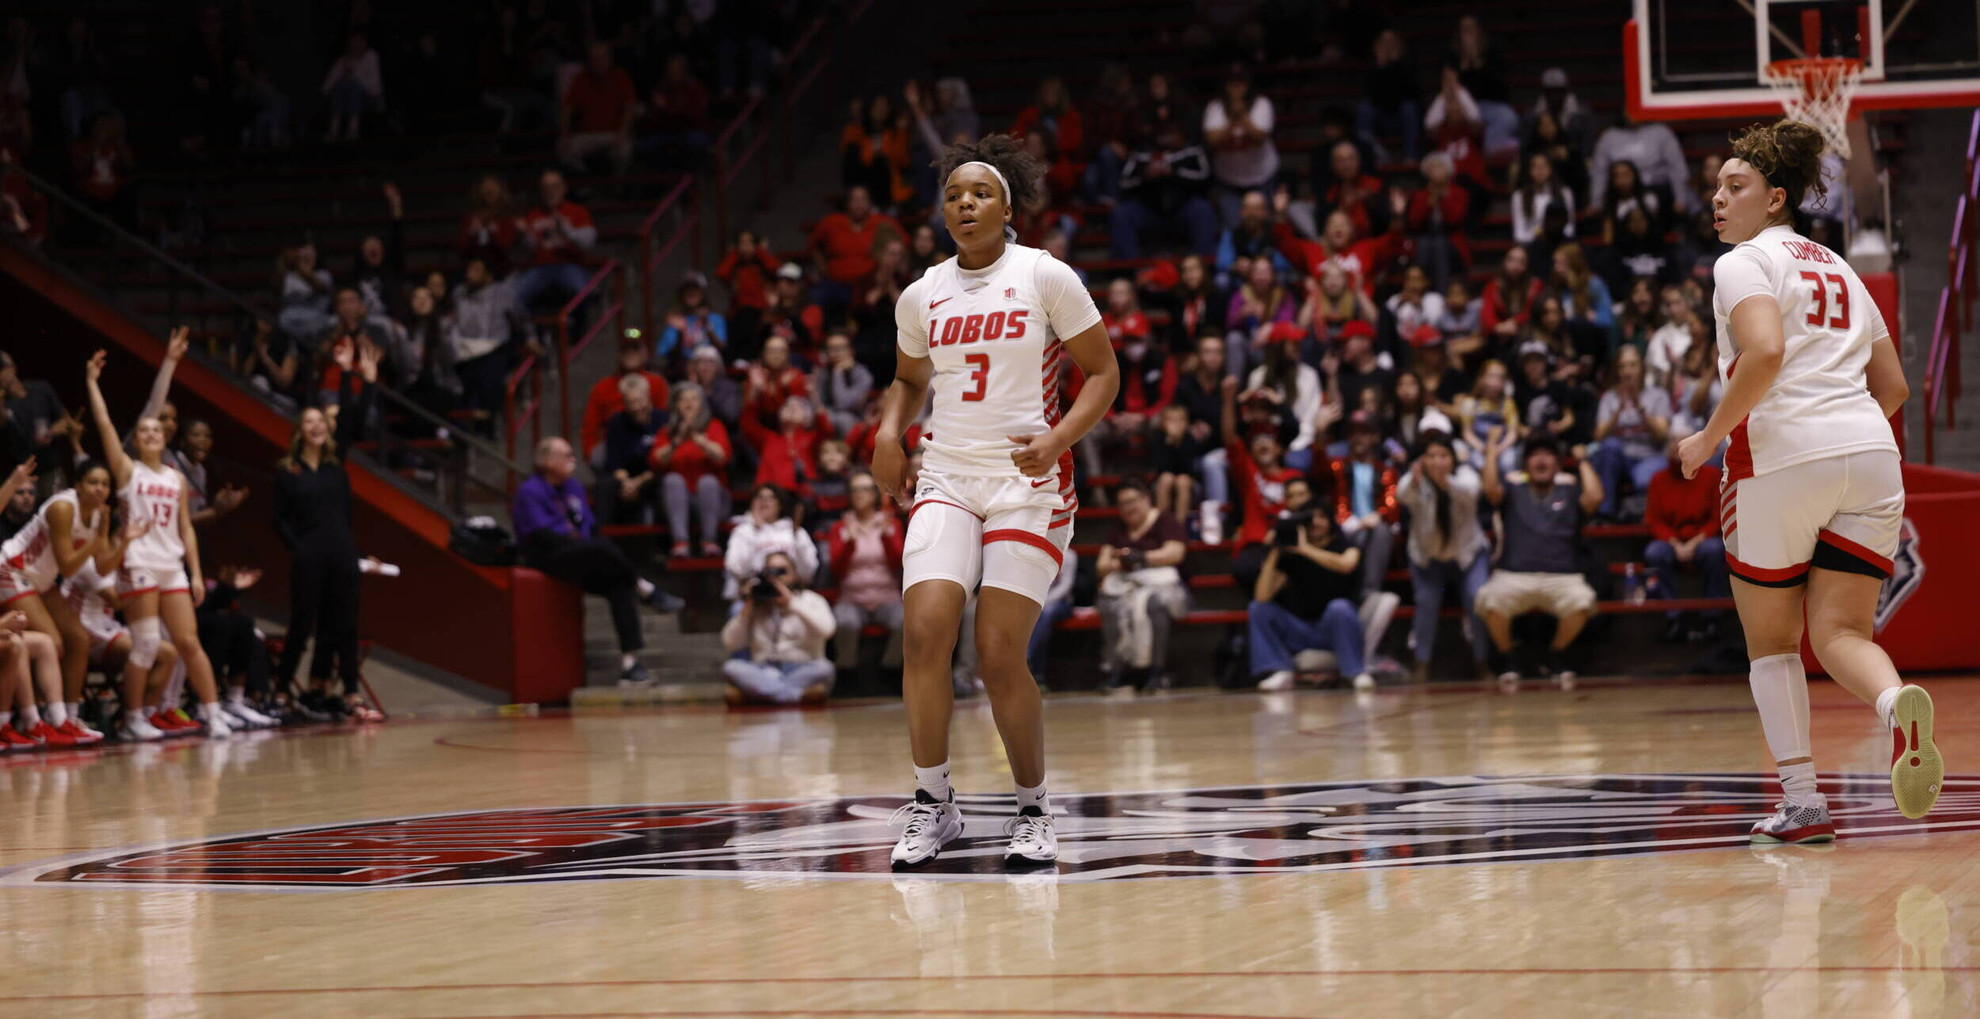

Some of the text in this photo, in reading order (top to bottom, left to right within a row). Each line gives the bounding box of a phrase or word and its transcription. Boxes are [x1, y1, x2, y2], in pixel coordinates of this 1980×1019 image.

[1799, 271, 1850, 330] 33
[928, 310, 1029, 348] LOBOS
[961, 353, 990, 401] 3
[152, 503, 172, 527] 13
